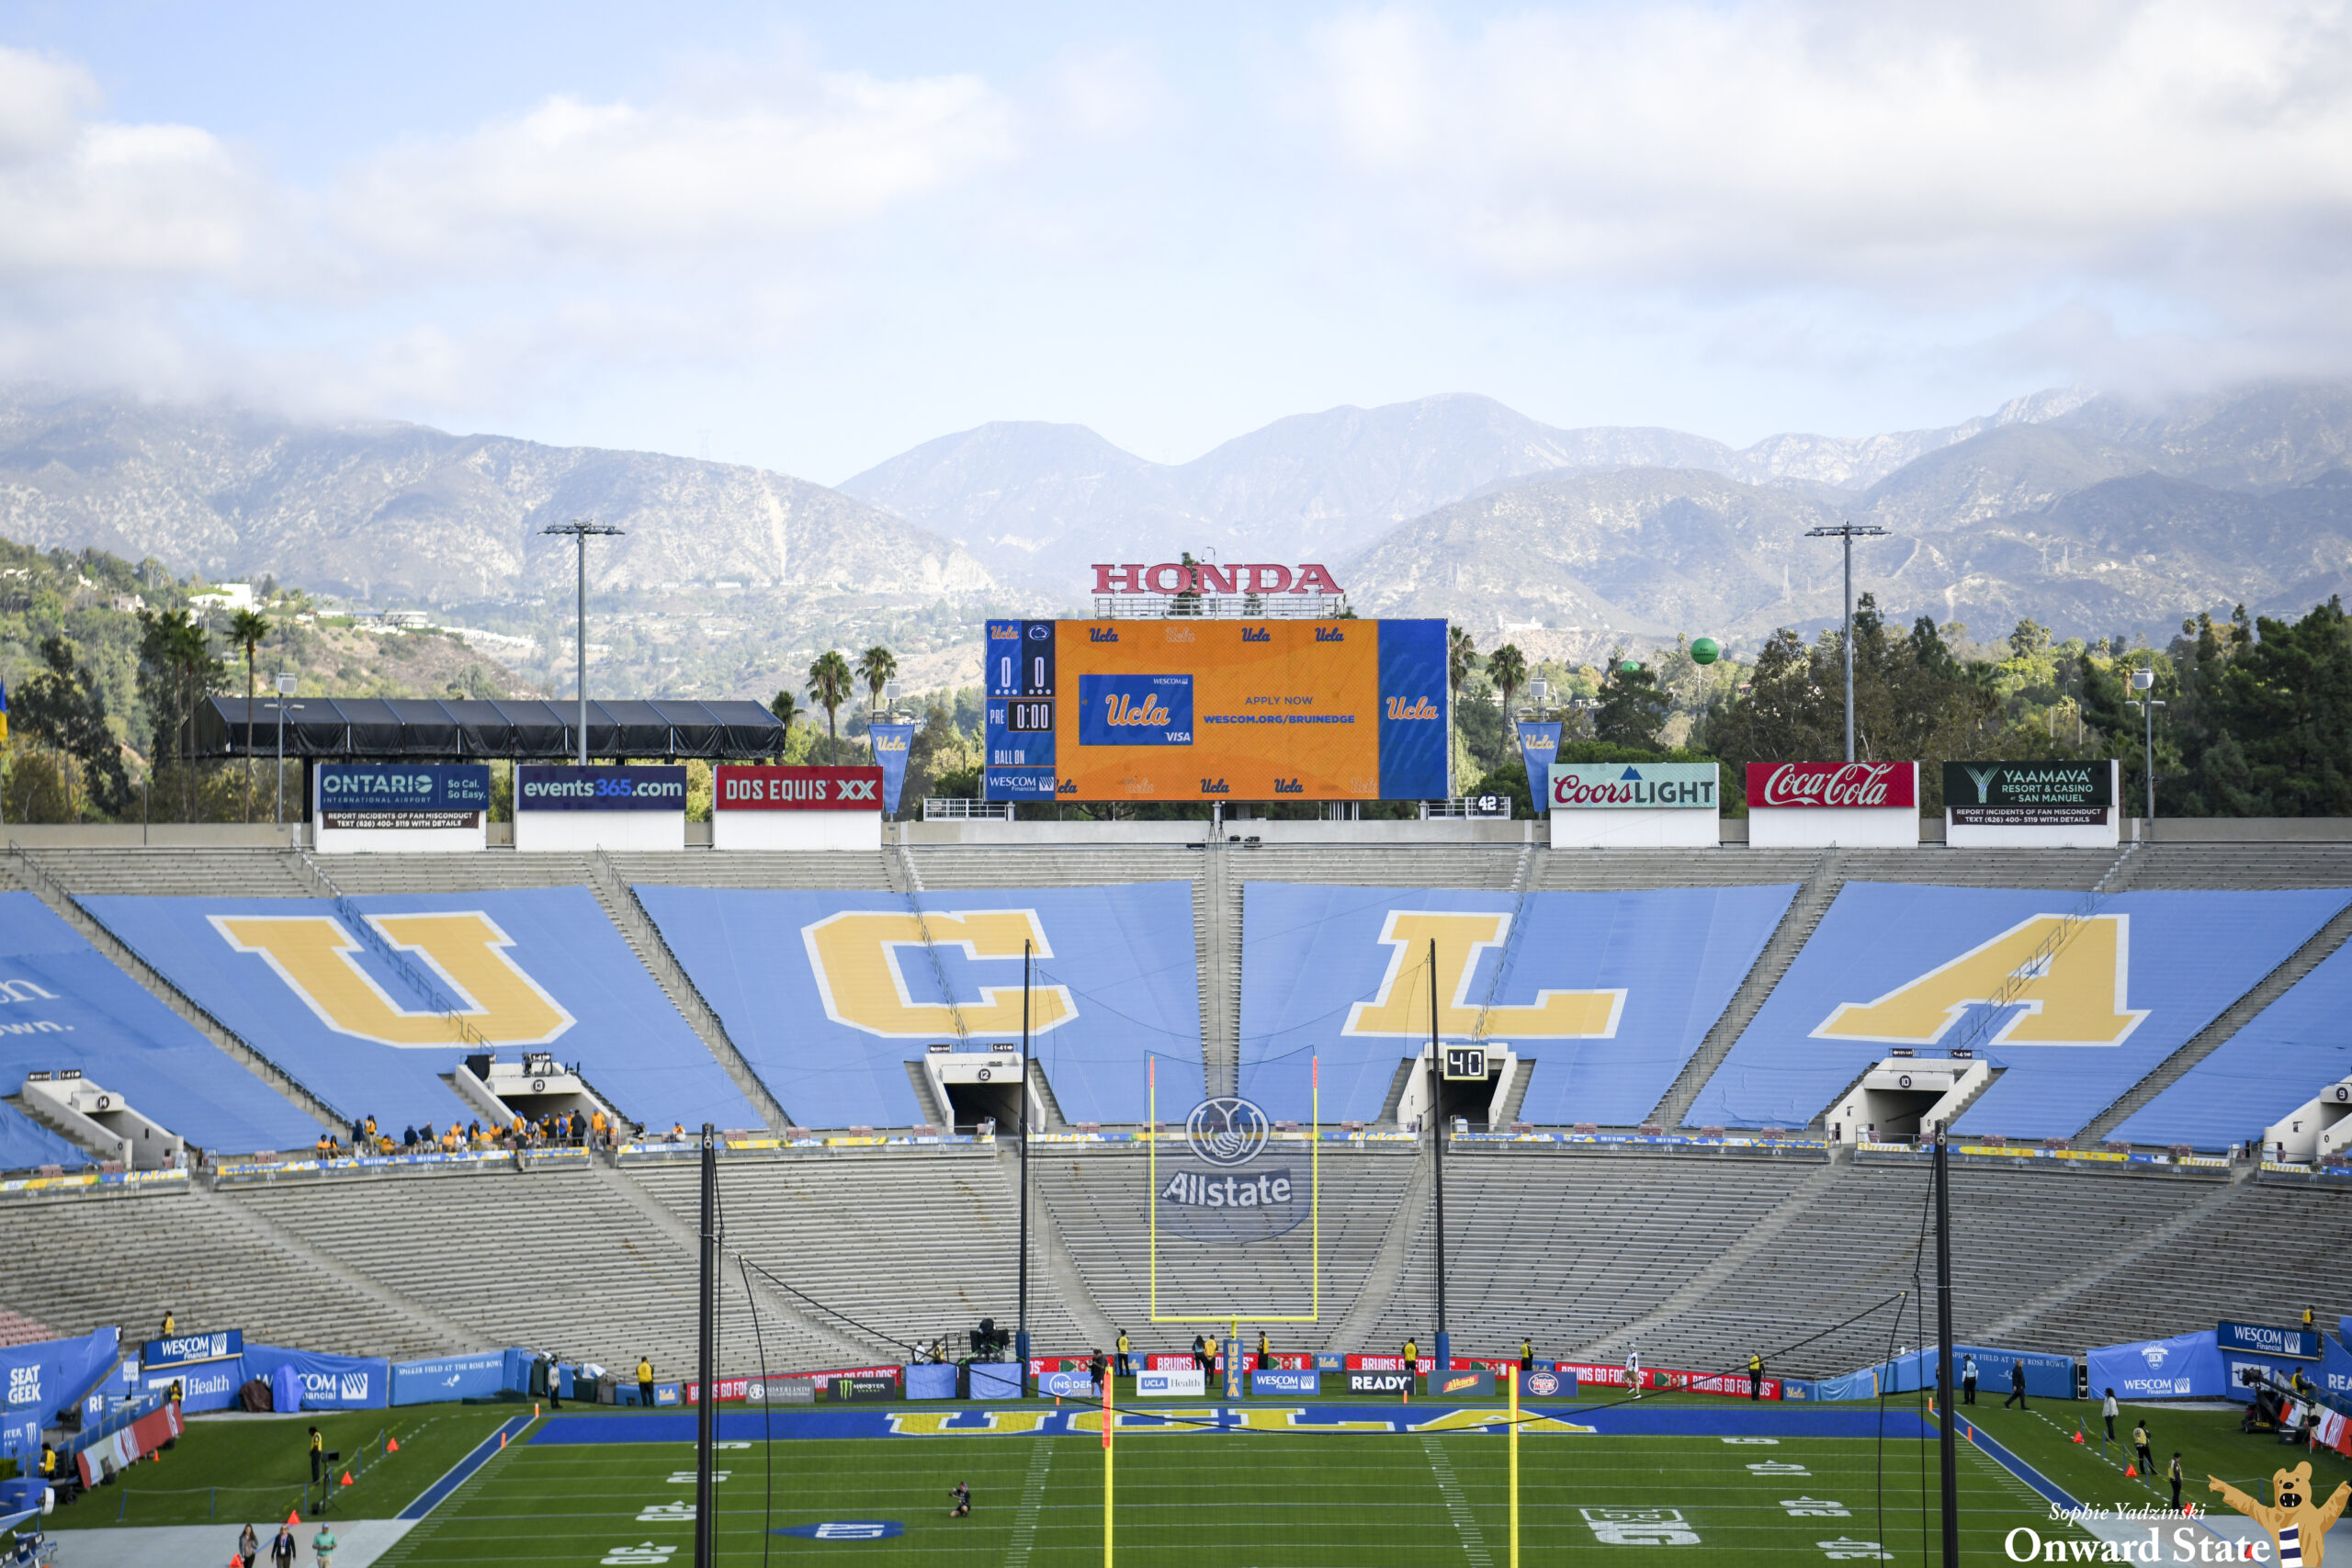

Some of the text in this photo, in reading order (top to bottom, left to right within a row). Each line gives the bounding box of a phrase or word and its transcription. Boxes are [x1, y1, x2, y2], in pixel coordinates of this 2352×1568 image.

[1091, 563, 1344, 594] HONDA
[990, 626, 1019, 640] Ucla
[1090, 627, 1119, 642] Ucla
[1241, 627, 1271, 642] Ucla
[1315, 627, 1344, 642] Ucla
[1001, 656, 1011, 688] 0
[1035, 656, 1045, 688] 0
[1245, 696, 1313, 705] APPLY NOW
[1385, 696, 1439, 720] Ucla
[989, 704, 1048, 728] PRE 0:00
[1105, 694, 1170, 726] Ucla
[1204, 715, 1355, 724] WESCOM.ORG/BRUINEDGE
[876, 735, 907, 751] Ucla
[1166, 732, 1191, 741] VISA
[1525, 734, 1555, 750] Ucla
[994, 750, 1025, 764] BALL ON
[323, 774, 433, 794] ONTARIO
[447, 780, 480, 788] So Cal.
[524, 778, 682, 796] events365.com
[989, 776, 1036, 787] WESCOM
[1057, 779, 1078, 794] cla
[1200, 778, 1230, 794] Ucla
[1274, 778, 1304, 794] Ucla
[1554, 774, 1714, 804] Coors LIGHT
[1764, 763, 1895, 806] Coca-Cola
[2002, 784, 2093, 793] RESORT & CASINO
[462, 791, 486, 800] Easy.
[726, 779, 876, 801] DOS EQUIS XX
[1478, 796, 1497, 811] 42
[1450, 1049, 1484, 1077] 40
[980, 1071, 989, 1079] 12
[535, 1081, 543, 1090] 13
[2339, 1090, 2346, 1099] 9
[98, 1098, 108, 1108] 14
[1162, 1172, 1292, 1207] Allstate
[2234, 1325, 2282, 1345] WESCOM
[162, 1337, 209, 1357] WESCOM
[2256, 1342, 2282, 1352] Financial
[184, 1350, 209, 1360] Financial
[1979, 1354, 1998, 1362] FIELD
[2028, 1358, 2044, 1366] ROSE
[2046, 1359, 2065, 1368] BOWL
[424, 1364, 443, 1373] FIELD
[445, 1363, 452, 1371] AT
[455, 1362, 467, 1371] THE
[486, 1359, 503, 1368] BOWL
[1158, 1357, 1193, 1371] BRUINS
[1227, 1343, 1239, 1397] UCLA
[1362, 1358, 1396, 1371] BRUINS
[10, 1364, 41, 1386] SEAT
[1257, 1376, 1298, 1385] WESCOM
[1595, 1368, 1607, 1382] GO
[188, 1375, 230, 1396] Health
[721, 1382, 732, 1396] GO
[1170, 1379, 1201, 1387] Health
[1692, 1375, 1751, 1394] BRUINS GO FOR
[2124, 1379, 2172, 1390] WESCOM
[8, 1383, 41, 1404] GEEK
[1746, 1463, 1812, 1476] 10
[1779, 1500, 1852, 1517] 20
[600, 1545, 678, 1564] 30
[1816, 1540, 1894, 1560] 30
